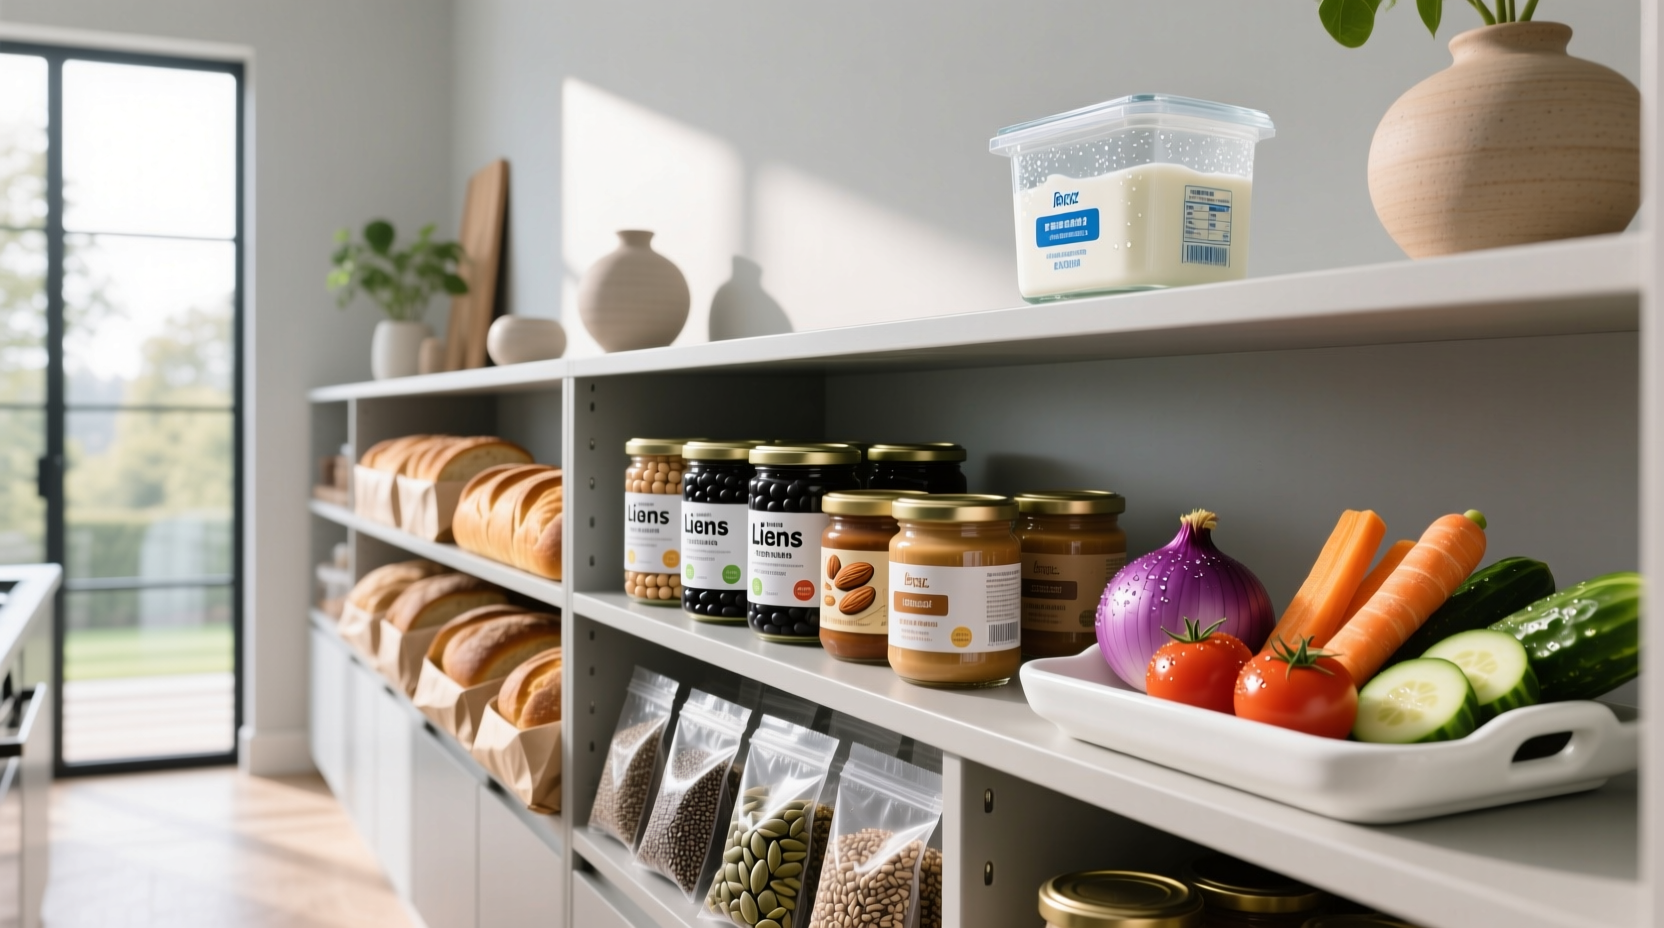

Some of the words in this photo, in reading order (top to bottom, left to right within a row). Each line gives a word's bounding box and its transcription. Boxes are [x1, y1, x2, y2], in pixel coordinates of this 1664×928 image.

[628, 504, 670, 525] Liens
[684, 513, 729, 536] Liens
[752, 521, 803, 548] Liens
